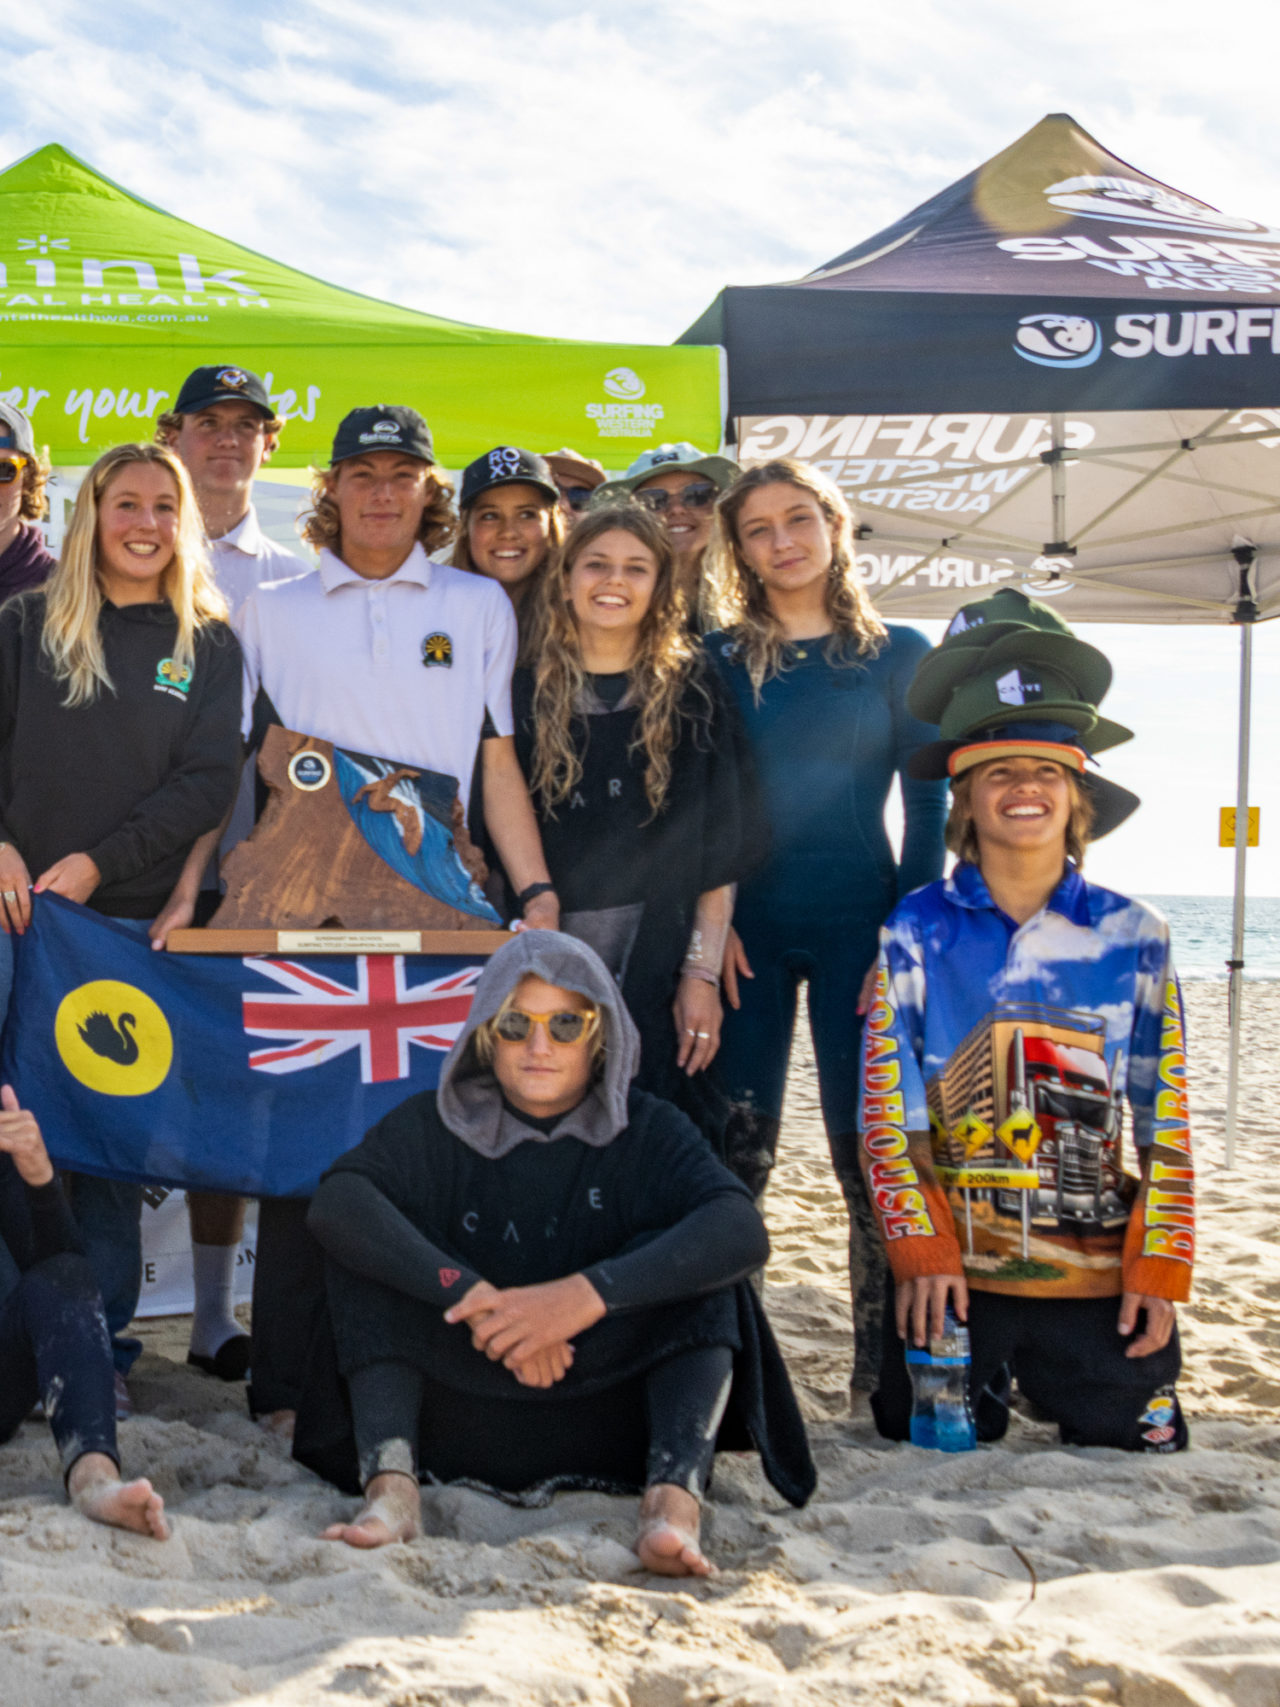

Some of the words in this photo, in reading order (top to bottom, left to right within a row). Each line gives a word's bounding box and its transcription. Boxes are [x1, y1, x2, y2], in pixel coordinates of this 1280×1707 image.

[996, 236, 1280, 268] SURF
[81, 293, 270, 308] HEALTH
[65, 389, 170, 443] your
[585, 403, 665, 419] SURFING
[596, 419, 656, 429] WESTERN
[597, 429, 653, 437] AUSTRALIA
